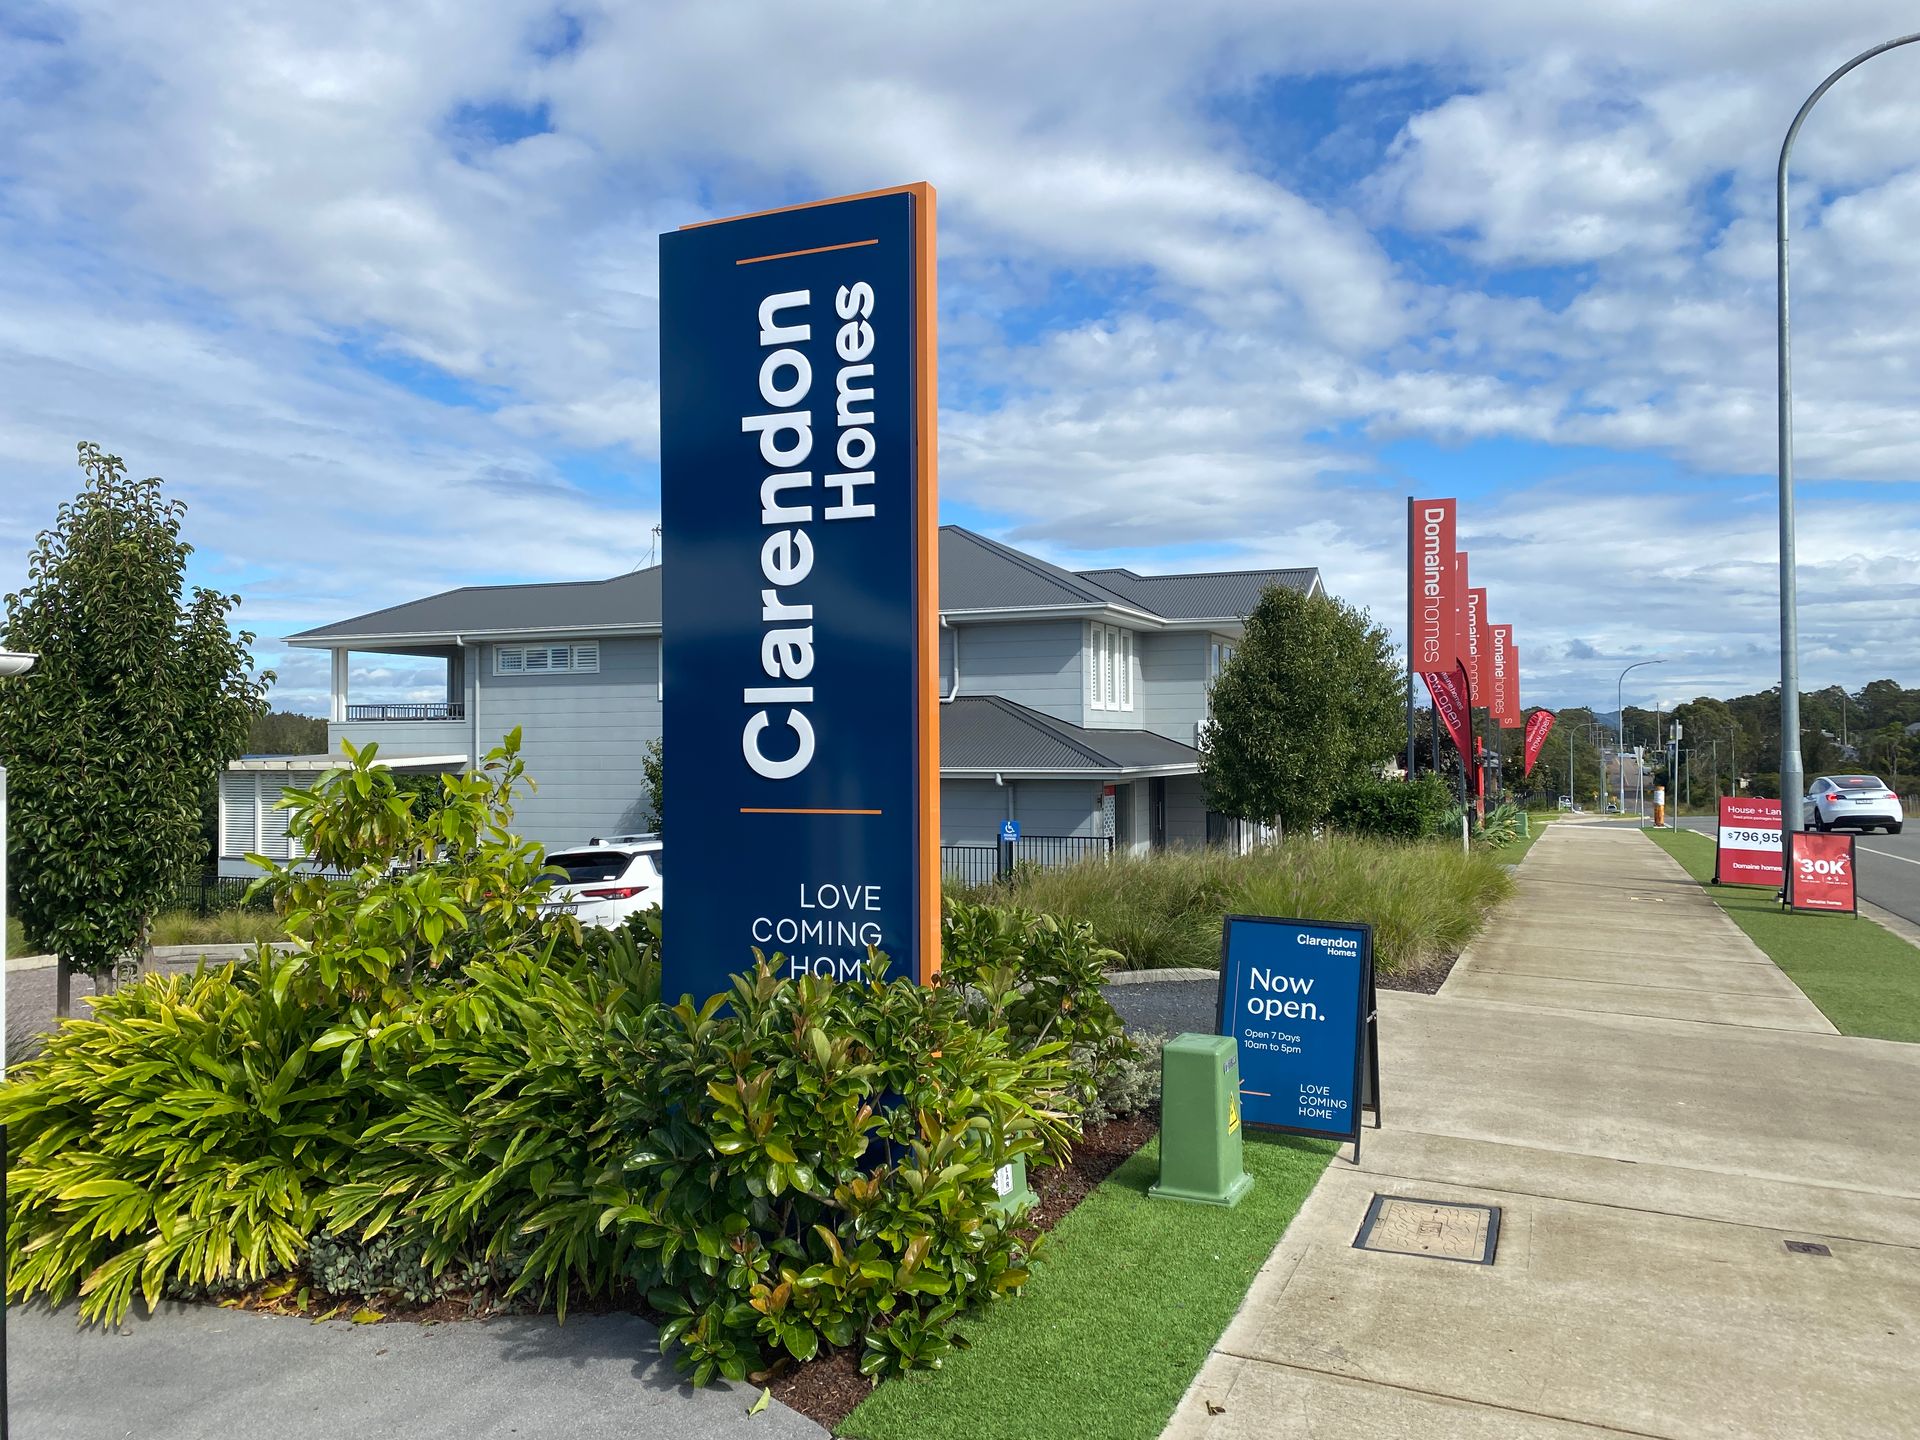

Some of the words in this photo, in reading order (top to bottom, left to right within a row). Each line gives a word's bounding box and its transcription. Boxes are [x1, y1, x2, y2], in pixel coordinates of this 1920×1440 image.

[824, 281, 876, 520] Homes
[742, 289, 816, 780] Clarendon
[1424, 507, 1445, 663] Domainehomes
[1494, 629, 1507, 714] Domainehomes
[1439, 695, 1462, 730] open
[1727, 805, 1756, 815] House
[1765, 807, 1782, 816] Lan
[1732, 862, 1760, 870] Domaine
[1800, 858, 1846, 875] 30K
[800, 883, 882, 911] LOVE
[752, 917, 882, 947] COMING
[1297, 933, 1358, 949] Clarendon
[1327, 947, 1358, 958] Homes
[1249, 967, 1315, 995] Now
[1247, 996, 1326, 1022] open.
[1244, 1028, 1270, 1040] Open
[1271, 1031, 1277, 1040] 7
[1278, 1032, 1302, 1043] Days
[1244, 1040, 1269, 1051] 10am
[1270, 1042, 1280, 1052] to
[1281, 1043, 1302, 1054] 5pm
[1300, 1083, 1330, 1096] LOVE
[1299, 1095, 1348, 1110] COMING
